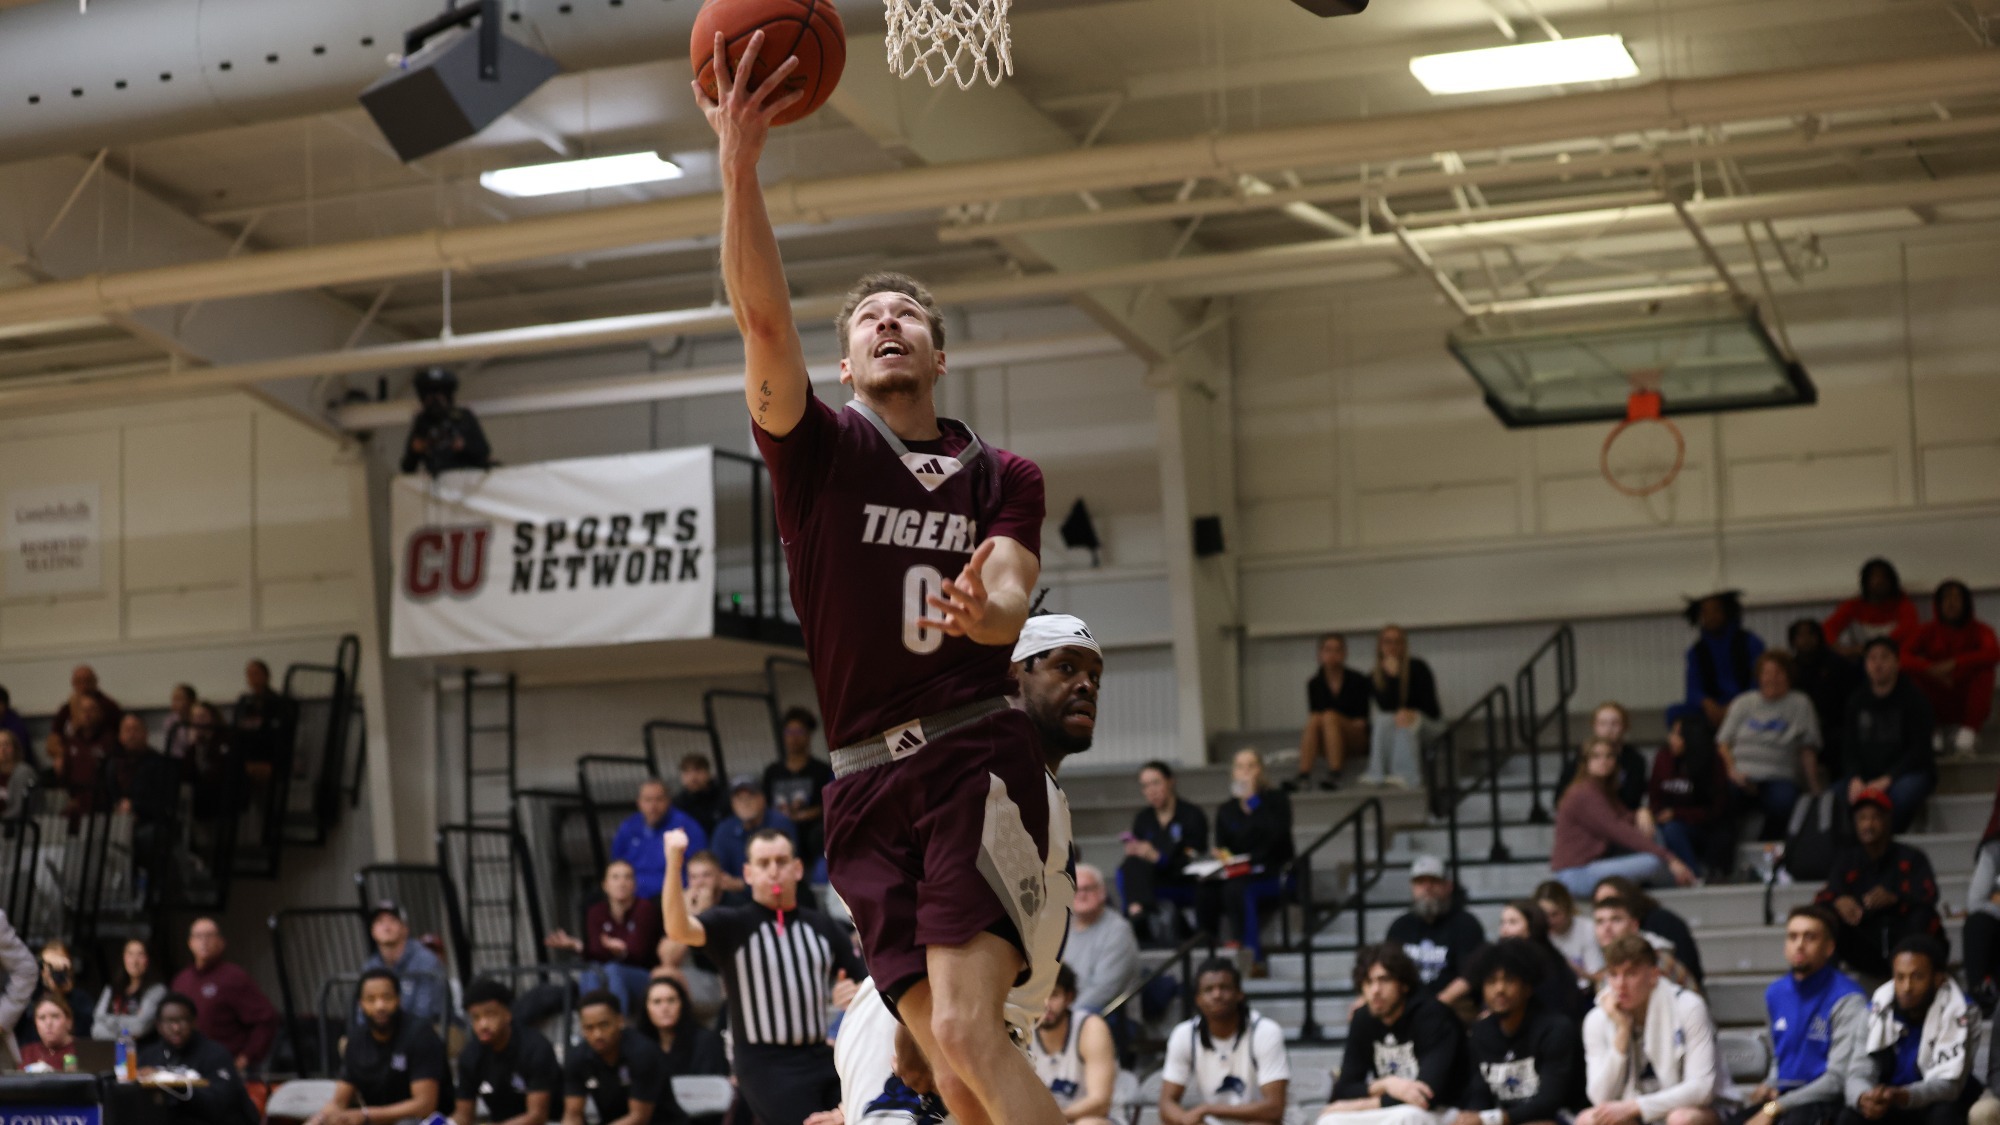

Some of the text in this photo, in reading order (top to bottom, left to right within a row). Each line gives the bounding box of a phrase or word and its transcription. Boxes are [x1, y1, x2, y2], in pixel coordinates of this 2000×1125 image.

[512, 508, 698, 554] SPORTS
[406, 526, 491, 599] CU
[512, 547, 701, 593] NETWORK
